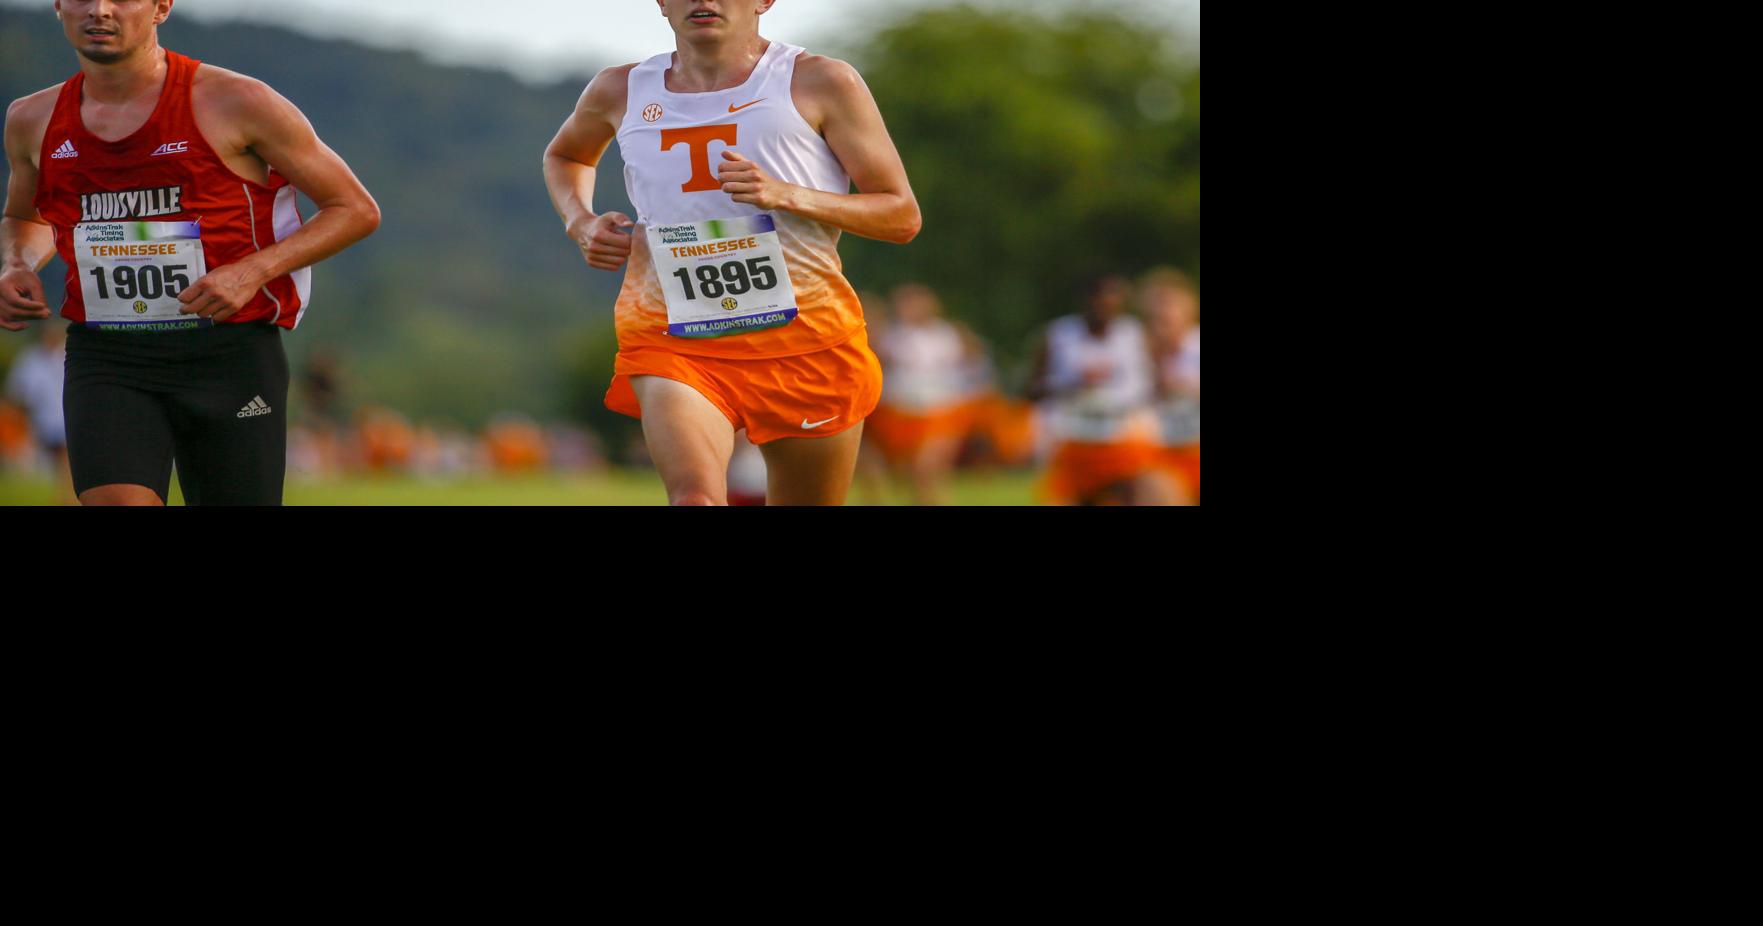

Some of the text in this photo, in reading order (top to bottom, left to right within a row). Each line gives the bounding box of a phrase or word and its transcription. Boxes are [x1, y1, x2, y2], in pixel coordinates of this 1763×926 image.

[643, 104, 662, 122] SEC
[51, 150, 78, 159] adidas
[150, 141, 189, 156] ACC
[660, 123, 737, 193] T
[81, 186, 181, 221] LOUISVILLE
[658, 225, 695, 233] AdkinsTrak
[662, 236, 698, 244] Associates
[670, 237, 757, 258] TENNESSEE
[90, 243, 177, 257] TENNESSEE
[90, 264, 190, 300] 1905
[673, 256, 778, 301] 1895
[721, 297, 738, 311] SEC
[684, 313, 785, 333] WWW.ADKINSTRAK.COM
[236, 406, 271, 418] adidas
